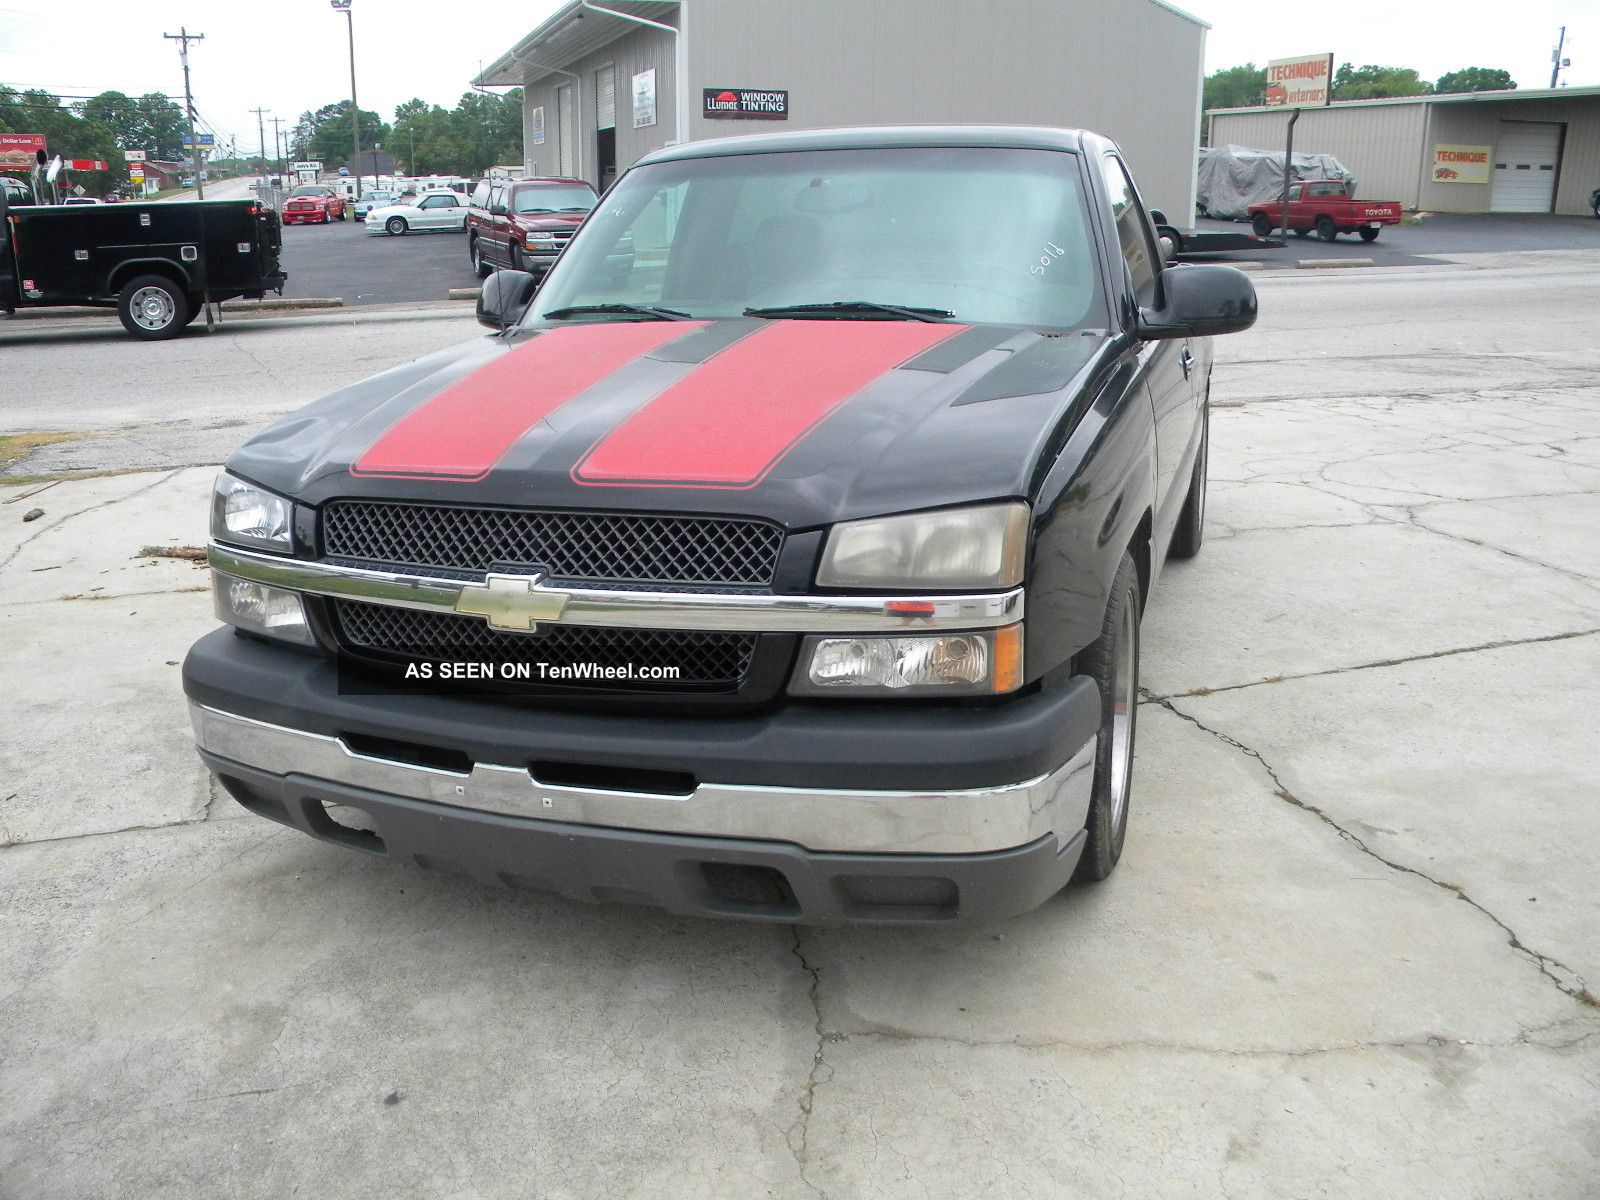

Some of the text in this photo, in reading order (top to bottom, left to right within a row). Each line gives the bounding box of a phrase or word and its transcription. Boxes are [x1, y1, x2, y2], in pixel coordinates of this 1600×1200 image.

[1270, 60, 1327, 80] TECHNIQUE
[741, 92, 784, 102] WINDOW
[741, 101, 784, 111] TINTING
[1437, 151, 1487, 163] TECHNIQUE
